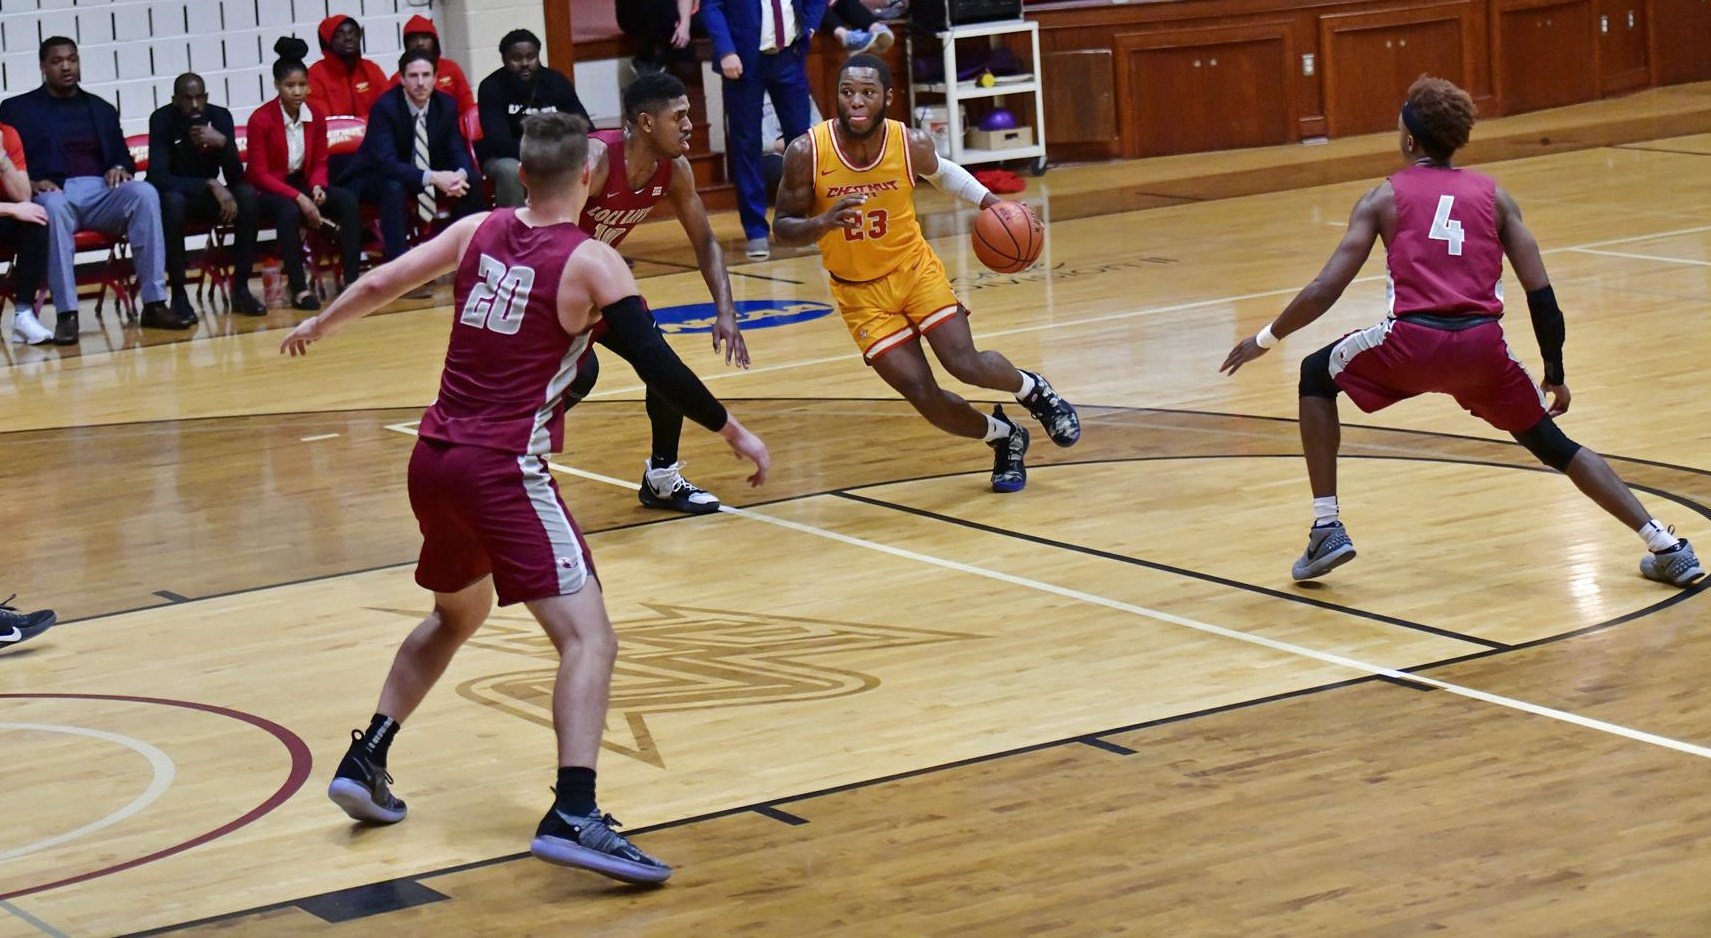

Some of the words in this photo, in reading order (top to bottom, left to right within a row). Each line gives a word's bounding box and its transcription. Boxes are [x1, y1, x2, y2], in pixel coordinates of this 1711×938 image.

[826, 179, 899, 198] CHESTNUT
[842, 209, 889, 243] 23
[1428, 194, 1466, 257] 4
[460, 252, 536, 336] 20
[658, 303, 833, 333] NAA
